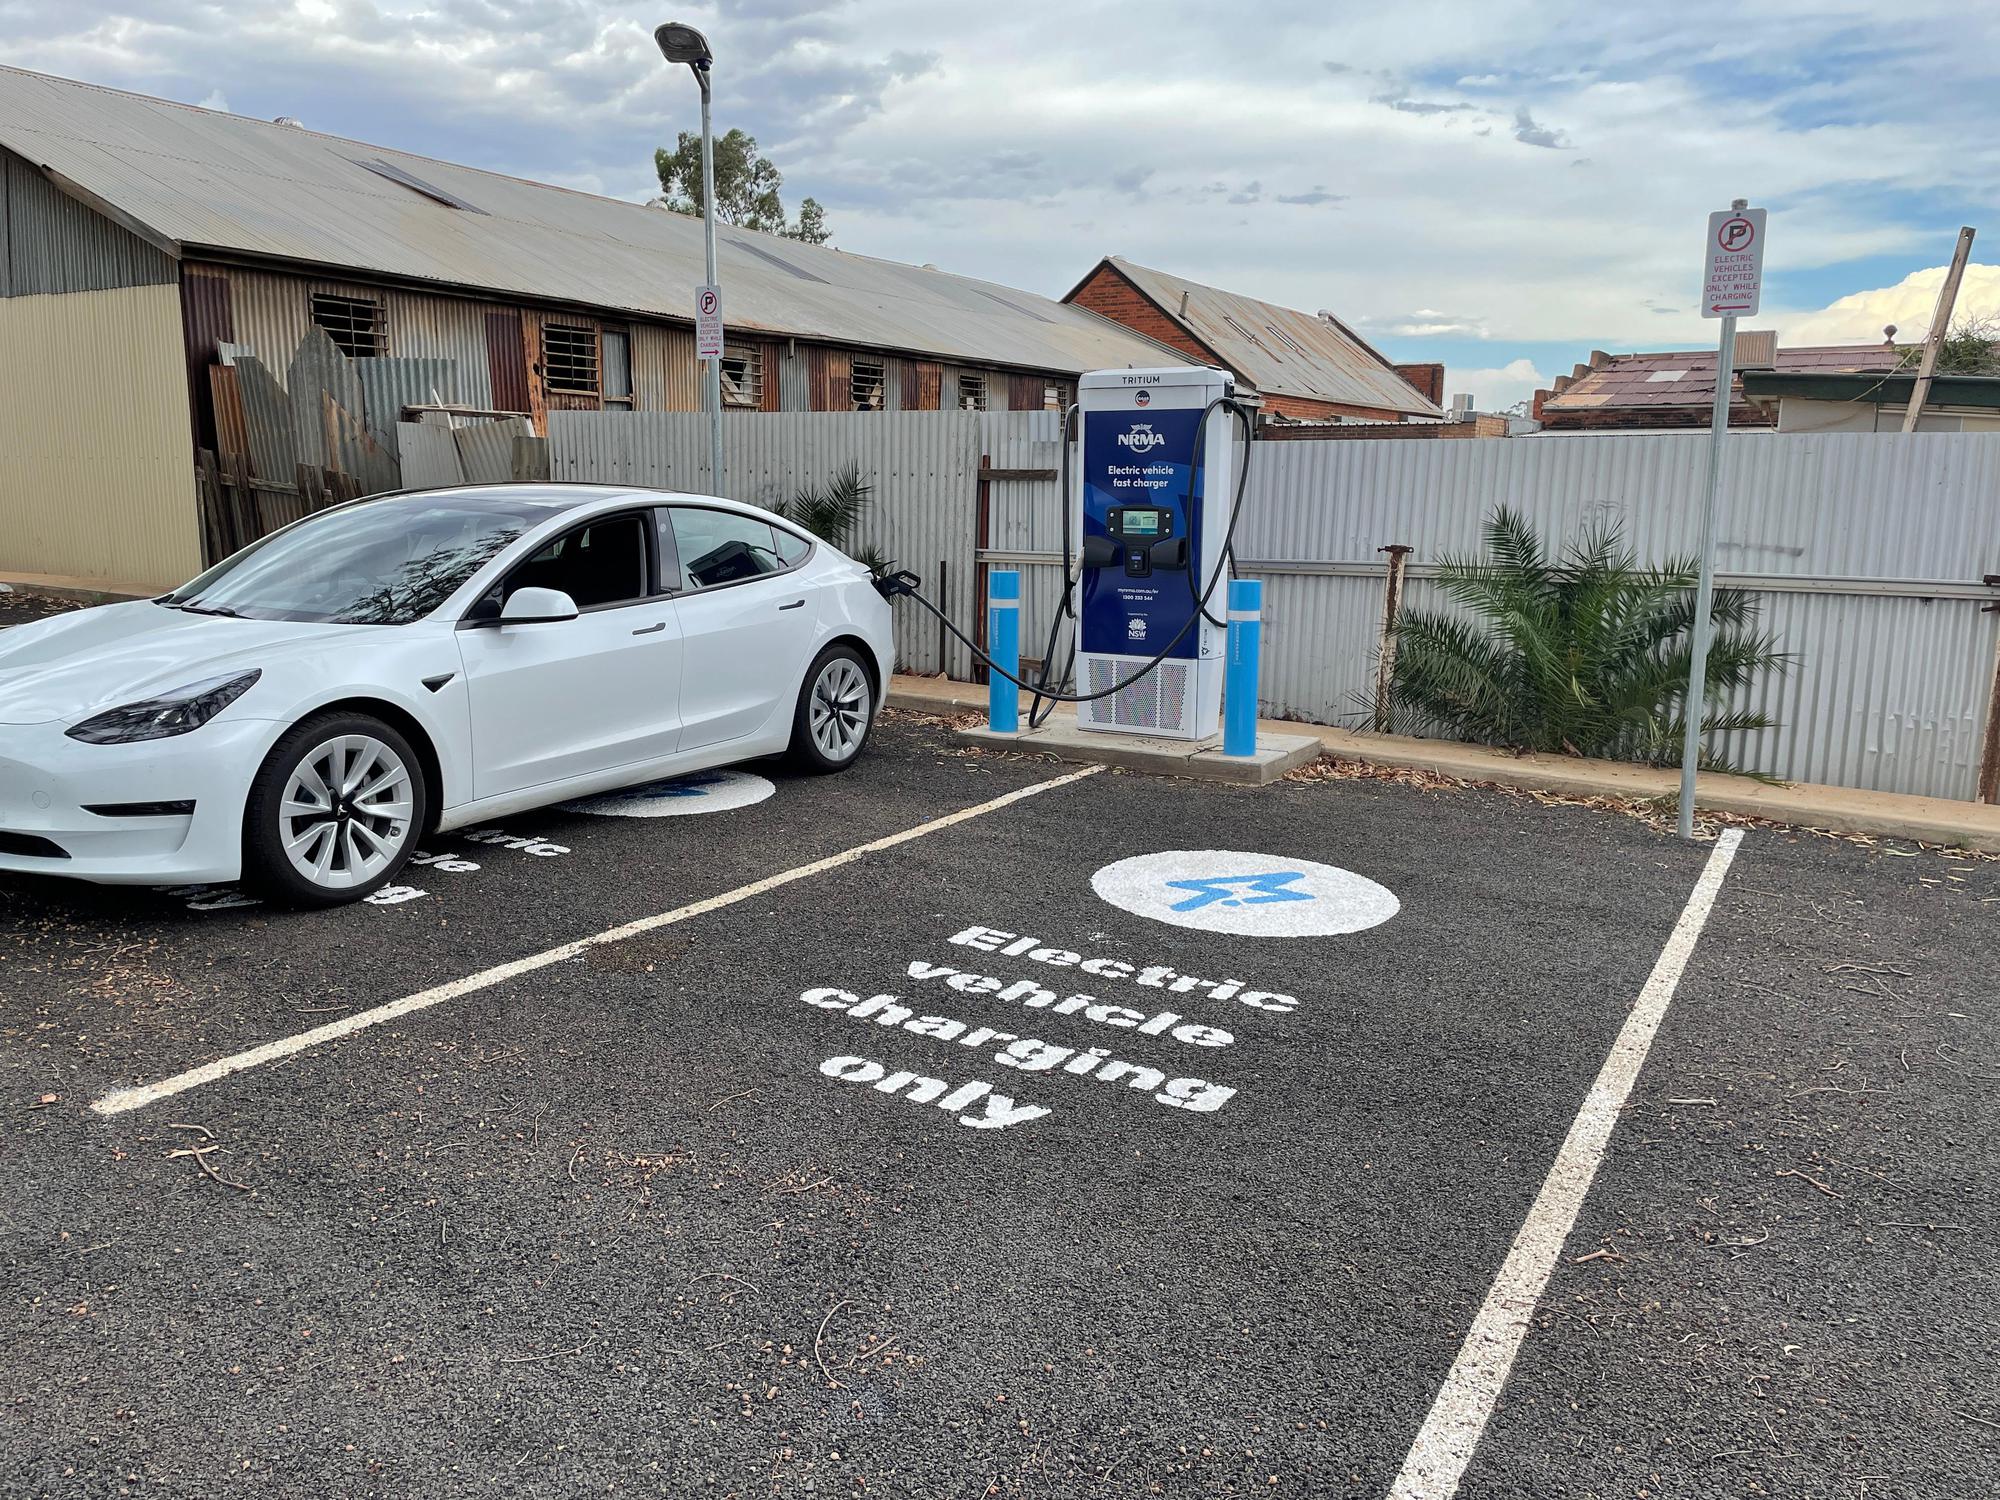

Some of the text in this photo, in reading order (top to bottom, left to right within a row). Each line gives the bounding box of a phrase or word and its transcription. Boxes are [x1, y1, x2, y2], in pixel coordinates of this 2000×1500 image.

[1714, 254, 1754, 264] ELECTRIC
[1714, 264, 1754, 273] VEHICLES
[1711, 273, 1754, 282] EXCEPTED
[1706, 284, 1728, 292] ONLY
[1710, 292, 1753, 301] CHARGING
[1122, 376, 1160, 385] TRITIUM
[1117, 433, 1165, 446] NRMA
[1108, 465, 1174, 475] Electric vehicle
[1112, 478, 1168, 490] fast charger
[1128, 630, 1147, 638] NSW
[947, 925, 1300, 1012] Electric
[907, 960, 1235, 1047] vehicle
[799, 987, 1238, 1112] charging
[819, 1055, 1053, 1130] only
